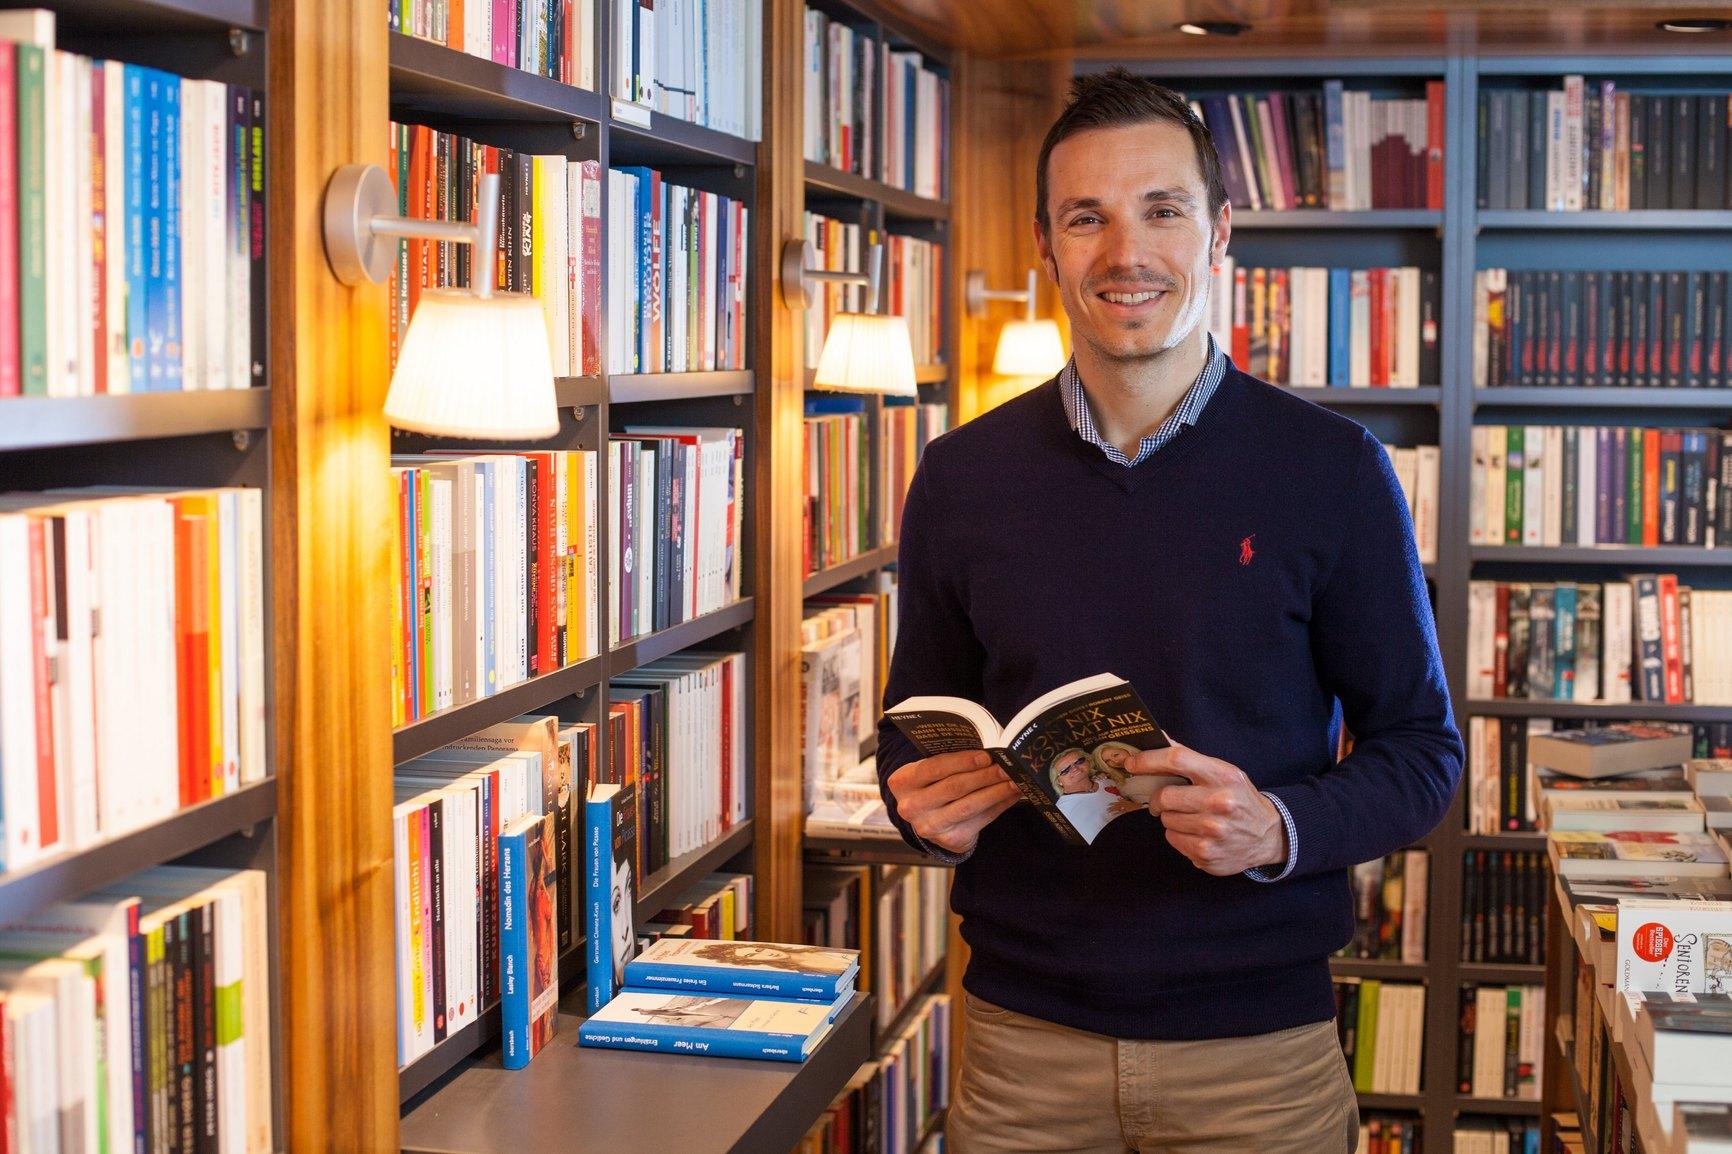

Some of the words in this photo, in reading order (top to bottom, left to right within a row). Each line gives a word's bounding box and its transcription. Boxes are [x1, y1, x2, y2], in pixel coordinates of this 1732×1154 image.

[400, 251, 408, 298] Kerouac
[400, 300, 408, 327] Jack
[891, 713, 918, 721] HEYNE
[1066, 707, 1106, 728] NIX
[1107, 710, 1150, 728] NIX
[1012, 726, 1034, 751] HEYNE
[1107, 725, 1155, 740] GEISSENS
[502, 847, 511, 880] Herzens
[435, 875, 440, 885] an
[503, 880, 511, 894] des
[411, 859, 421, 926] Endlich!
[504, 895, 512, 931] Nomadin
[1655, 926, 1663, 957] SPIEGEL
[506, 954, 514, 975] Blanch
[1673, 933, 1699, 993] SENIOREN
[507, 976, 515, 995] Lesley
[645, 975, 682, 985] Frauenzimmer
[683, 978, 698, 986] freies
[761, 983, 780, 992] Barbara
[583, 1034, 611, 1043] Gedichte
[611, 1035, 624, 1043] und
[623, 1036, 659, 1047] Erzählungen
[673, 1040, 695, 1051] Meer
[695, 1041, 710, 1051] Am
[762, 1047, 789, 1056] ebersbach
